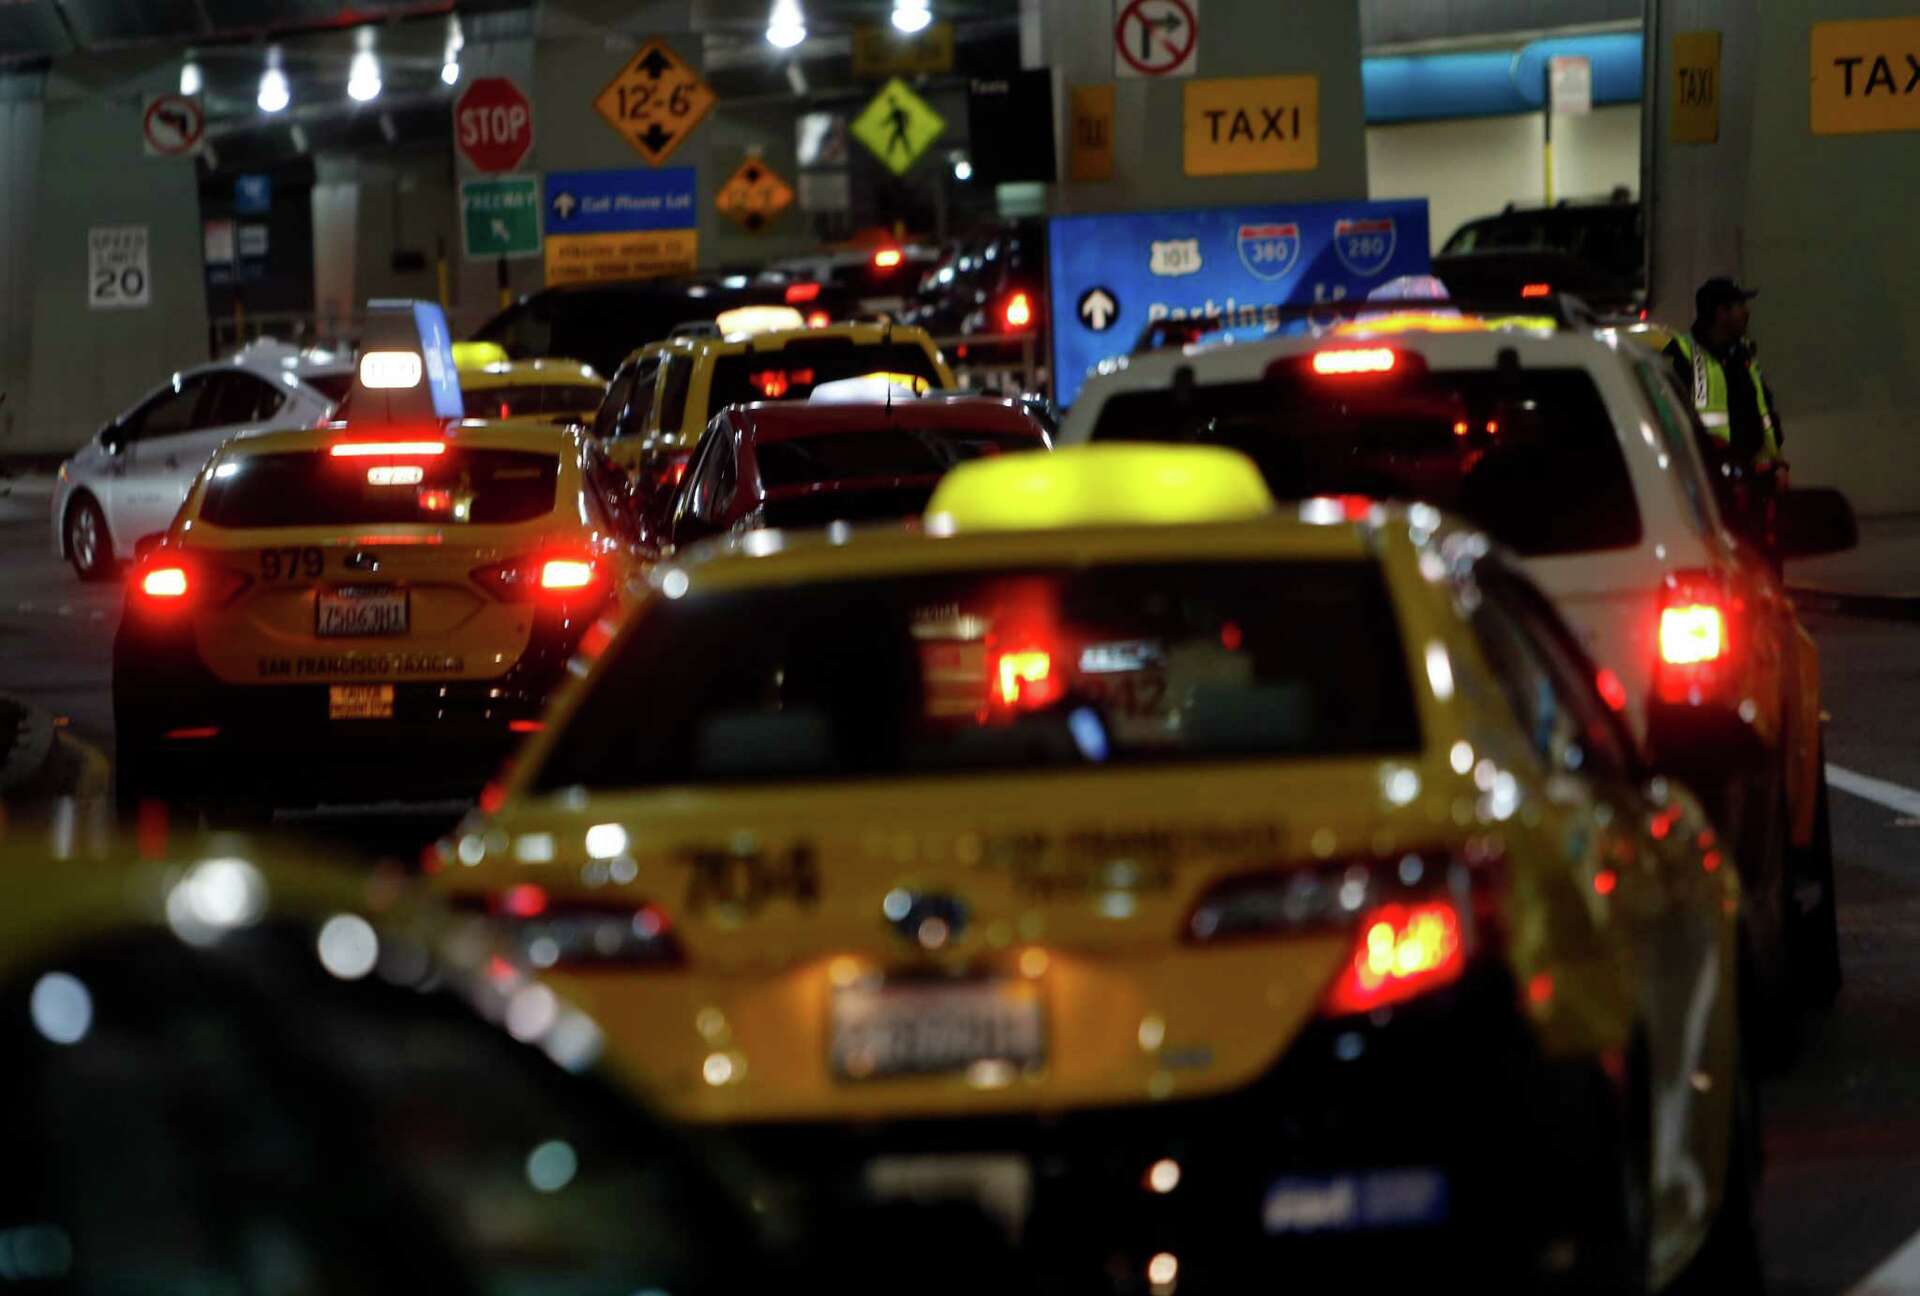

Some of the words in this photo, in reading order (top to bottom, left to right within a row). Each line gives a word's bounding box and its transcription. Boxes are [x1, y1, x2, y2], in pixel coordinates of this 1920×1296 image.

[1679, 66, 1713, 106] TAXI
[461, 104, 527, 147] STOP
[1203, 106, 1299, 142] TAXI
[1162, 246, 1190, 270] 101
[1252, 241, 1288, 263] 380
[1347, 237, 1385, 258] 280
[95, 267, 144, 298] 20
[260, 546, 325, 580] 979
[257, 657, 291, 675] SAN
[296, 655, 390, 674] FRANCISCO
